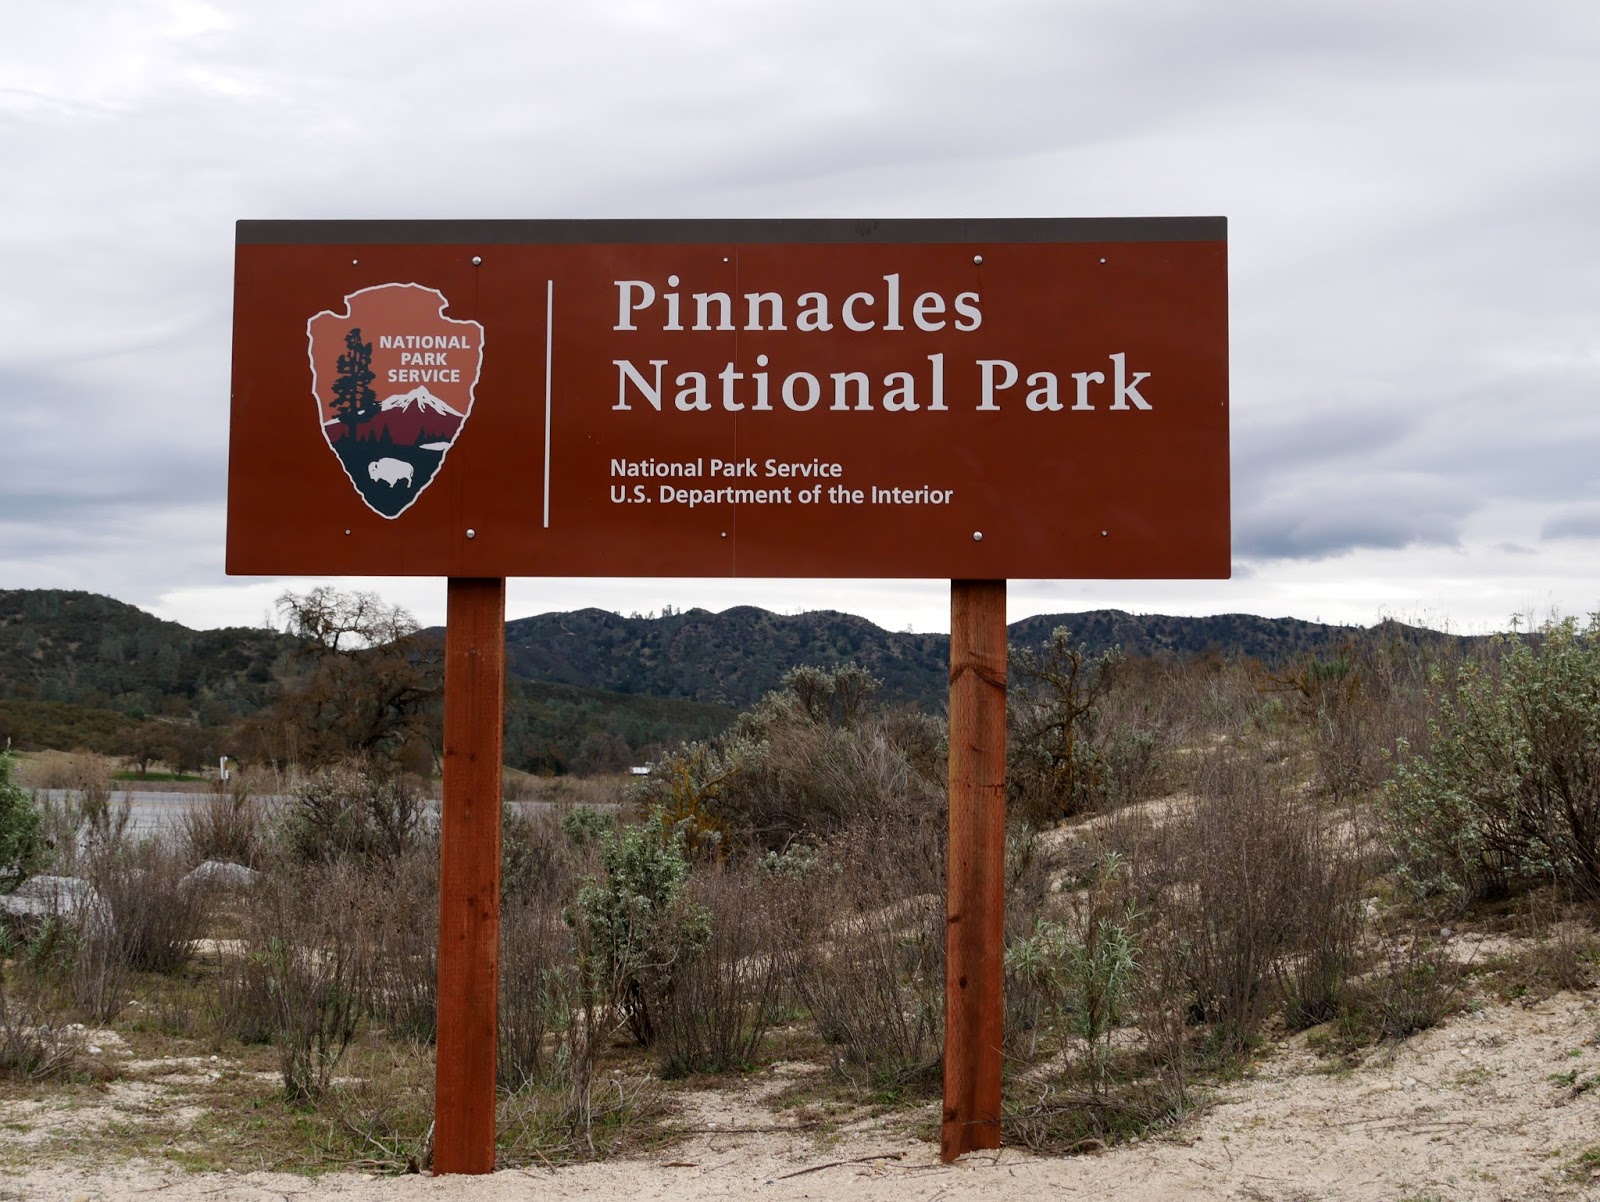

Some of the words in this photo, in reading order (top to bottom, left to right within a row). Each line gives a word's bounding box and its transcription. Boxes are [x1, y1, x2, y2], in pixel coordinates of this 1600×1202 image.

[612, 272, 982, 333] Pinnacles
[379, 335, 471, 350] NATIONAL
[400, 352, 448, 366] PARK
[387, 368, 461, 383] SERVICE
[611, 352, 949, 413] National
[975, 352, 1153, 413] Park
[610, 457, 703, 478] National
[710, 457, 758, 478] Park
[765, 458, 843, 478] Service
[610, 484, 652, 504] U.S.
[659, 485, 792, 508] Department
[798, 484, 822, 504] of
[827, 484, 865, 504] the
[871, 485, 954, 505] Interior
